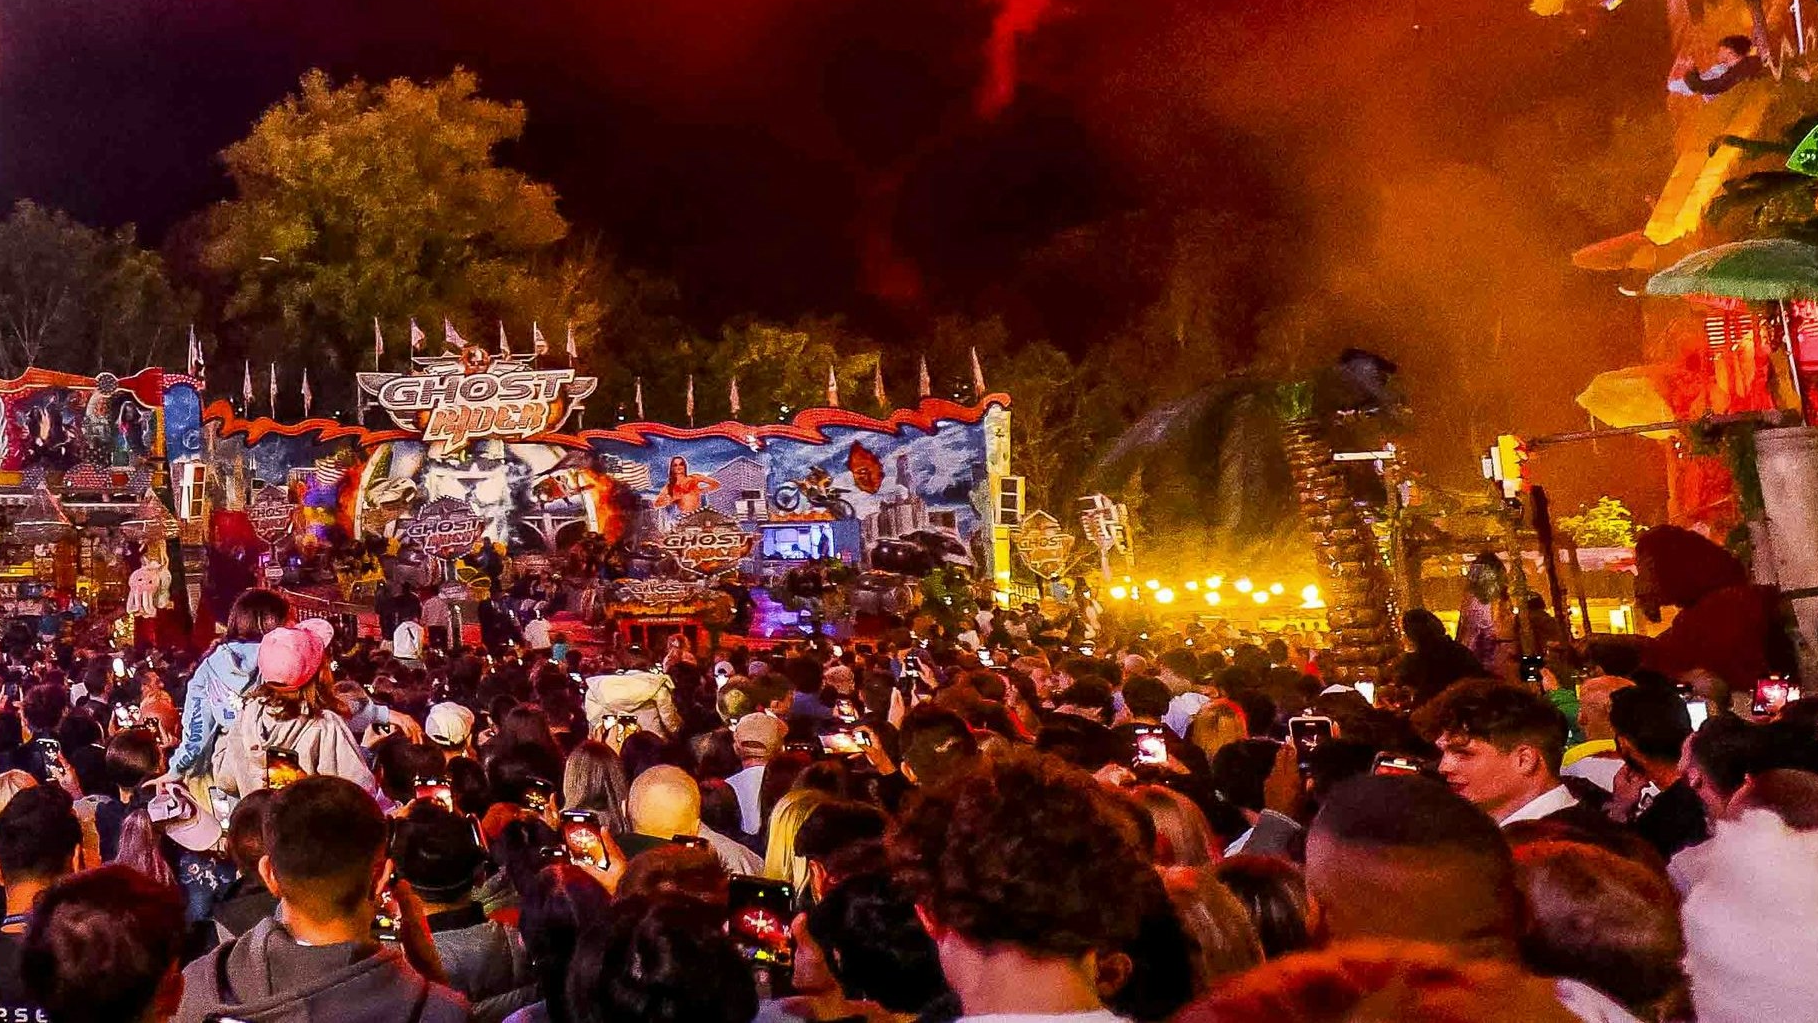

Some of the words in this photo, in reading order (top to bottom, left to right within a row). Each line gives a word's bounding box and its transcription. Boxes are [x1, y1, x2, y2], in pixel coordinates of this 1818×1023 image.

[381, 370, 574, 406] GHOST
[430, 401, 546, 445] RIDER
[409, 518, 481, 535] GHOST
[664, 533, 751, 547] GHOST
